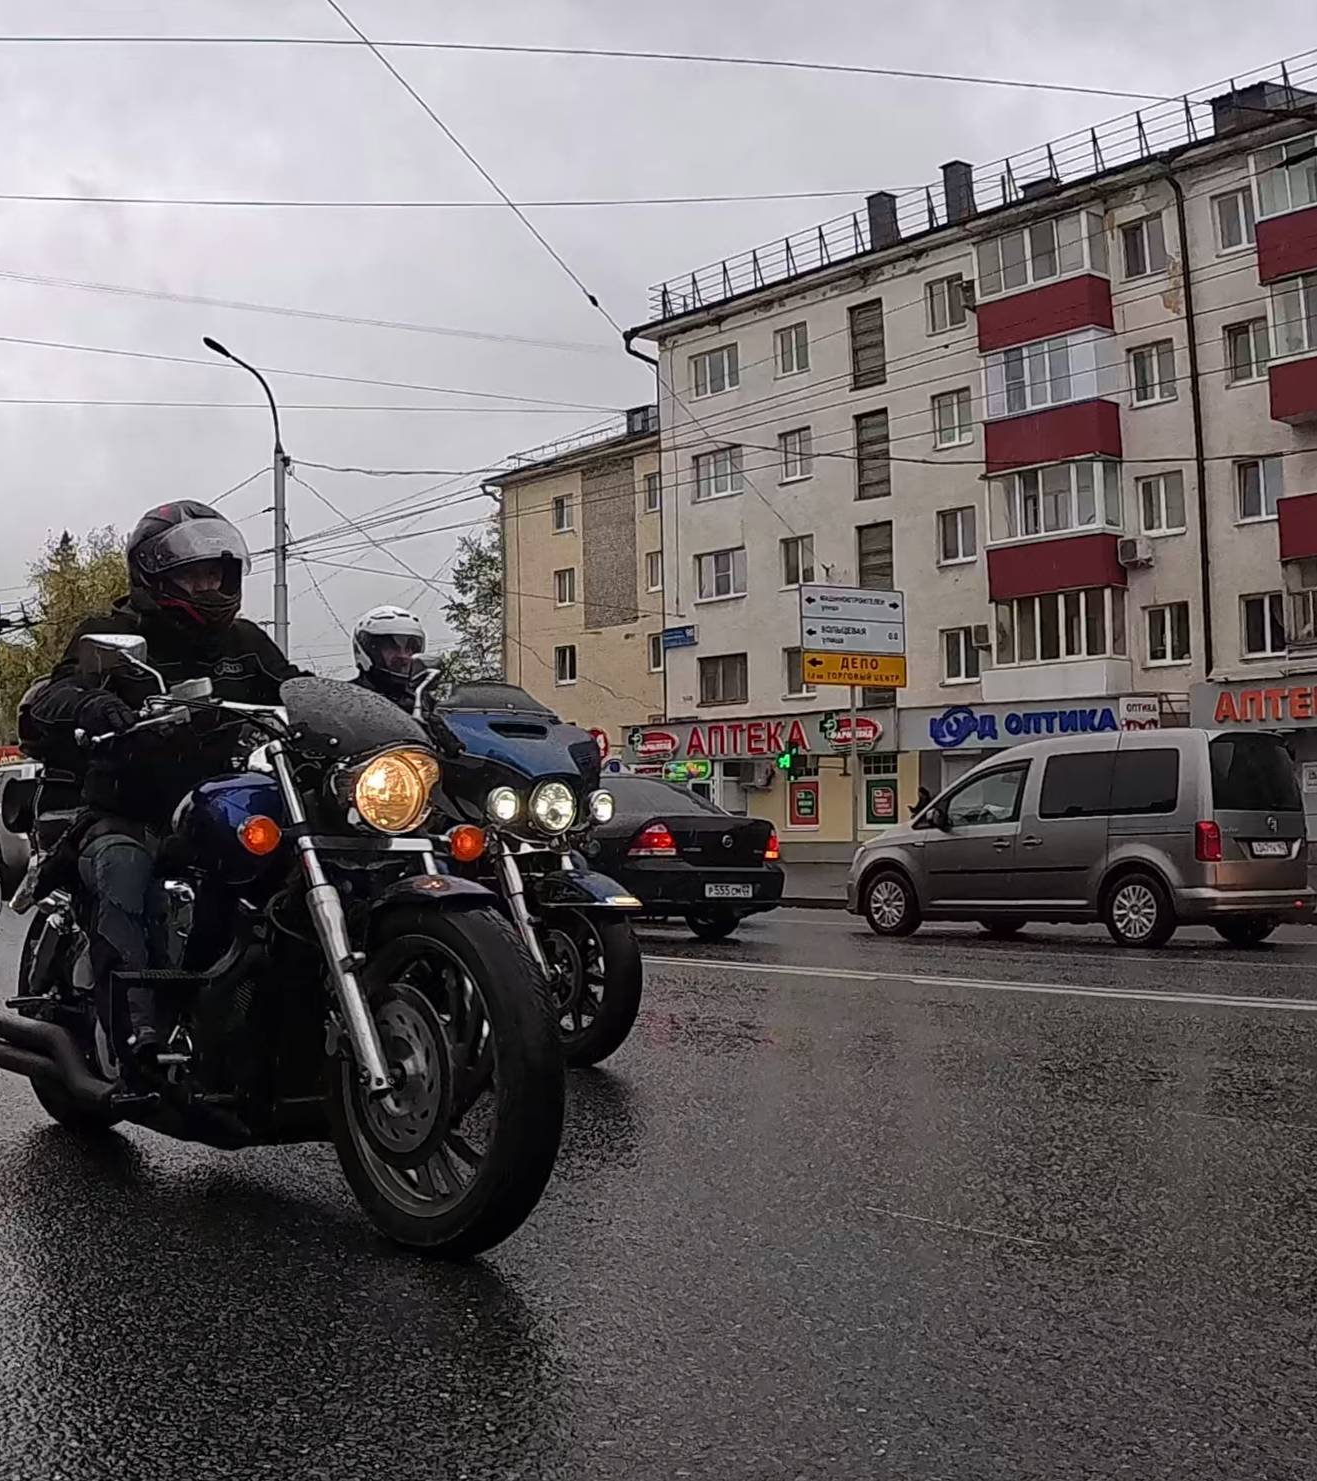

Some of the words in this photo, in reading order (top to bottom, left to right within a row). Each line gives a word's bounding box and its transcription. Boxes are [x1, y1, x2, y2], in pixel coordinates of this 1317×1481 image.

[840, 657, 879, 671] ДЕПО
[827, 671, 871, 682] ТОРГОВЫЙ
[873, 674, 900, 682] ЦЕНТР
[1126, 703, 1157, 713] ОПТИКА
[1213, 685, 1317, 724] АПТЕ
[1004, 707, 1119, 736] ОПТИКА
[686, 718, 812, 758] АПТЕКА
